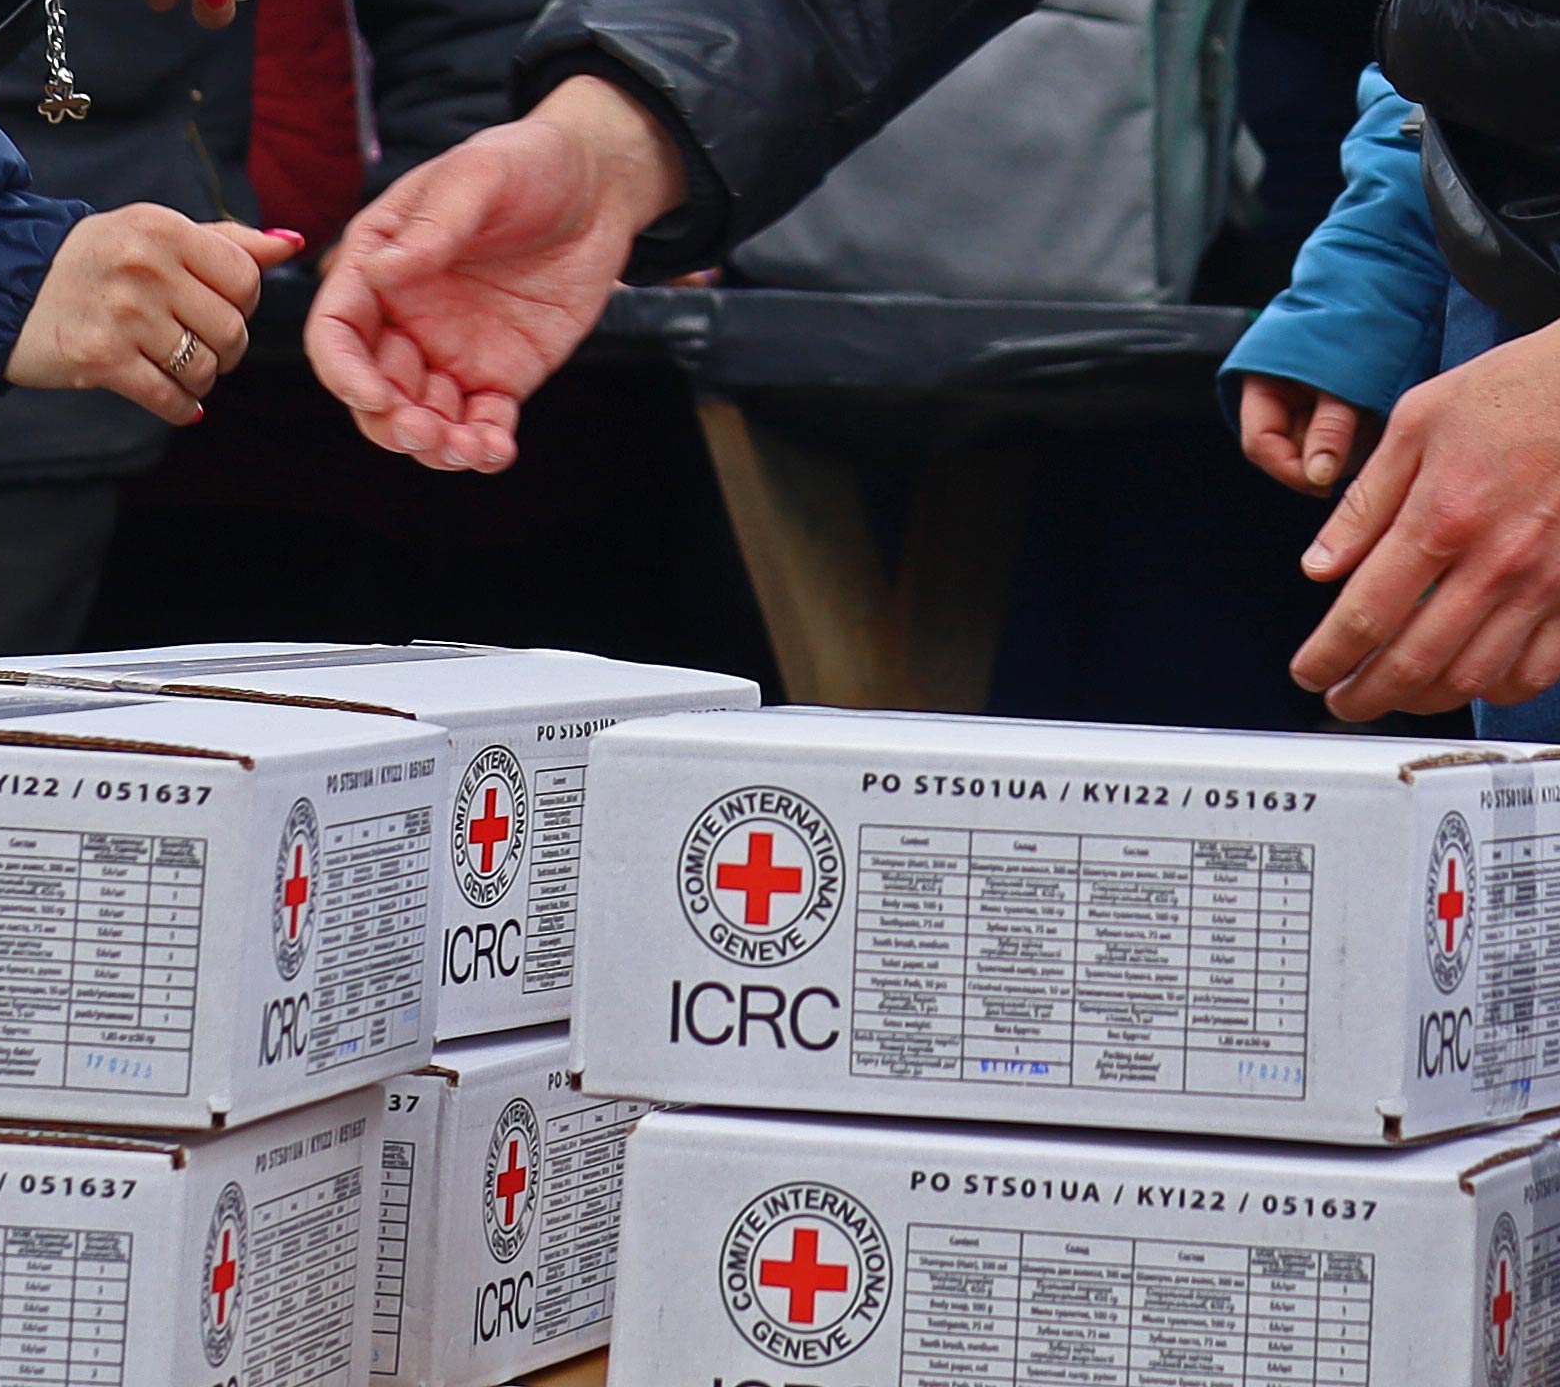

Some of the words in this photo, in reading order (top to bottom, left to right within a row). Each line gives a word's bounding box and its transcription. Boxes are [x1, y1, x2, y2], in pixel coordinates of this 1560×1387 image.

[537, 725, 556, 742] PO
[72, 779, 84, 799] /
[96, 780, 212, 806] 051637
[456, 773, 473, 867] COMITE
[473, 750, 526, 862] INTERNATIONAL
[862, 772, 901, 794] PO
[914, 775, 1047, 801] STS01UA
[1060, 782, 1070, 802] /
[1083, 783, 1169, 806] KYI22
[1182, 788, 1192, 807] /
[1204, 789, 1317, 812] 051637
[463, 868, 509, 905] GENEVE
[685, 815, 721, 915] COMITE
[720, 792, 838, 922] INTERNATIONAL
[441, 919, 521, 986] ICRC
[709, 924, 806, 961] GENEVE
[258, 992, 310, 1067] ICRC
[669, 980, 840, 1051] ICRC
[1417, 1007, 1473, 1078] ICRC
[19, 1174, 137, 1200] 051637
[910, 1170, 951, 1193] PO
[964, 1174, 1100, 1203] STS01UA
[1113, 1185, 1124, 1205] /
[1137, 1186, 1225, 1211] KYI22
[1238, 1193, 1249, 1214] /
[1262, 1195, 1377, 1221] 051637
[728, 1210, 767, 1312] COMITE
[764, 1189, 886, 1323] INTERNATIONAL
[474, 1271, 535, 1345] ICRC
[752, 1320, 852, 1361] GENEVE
